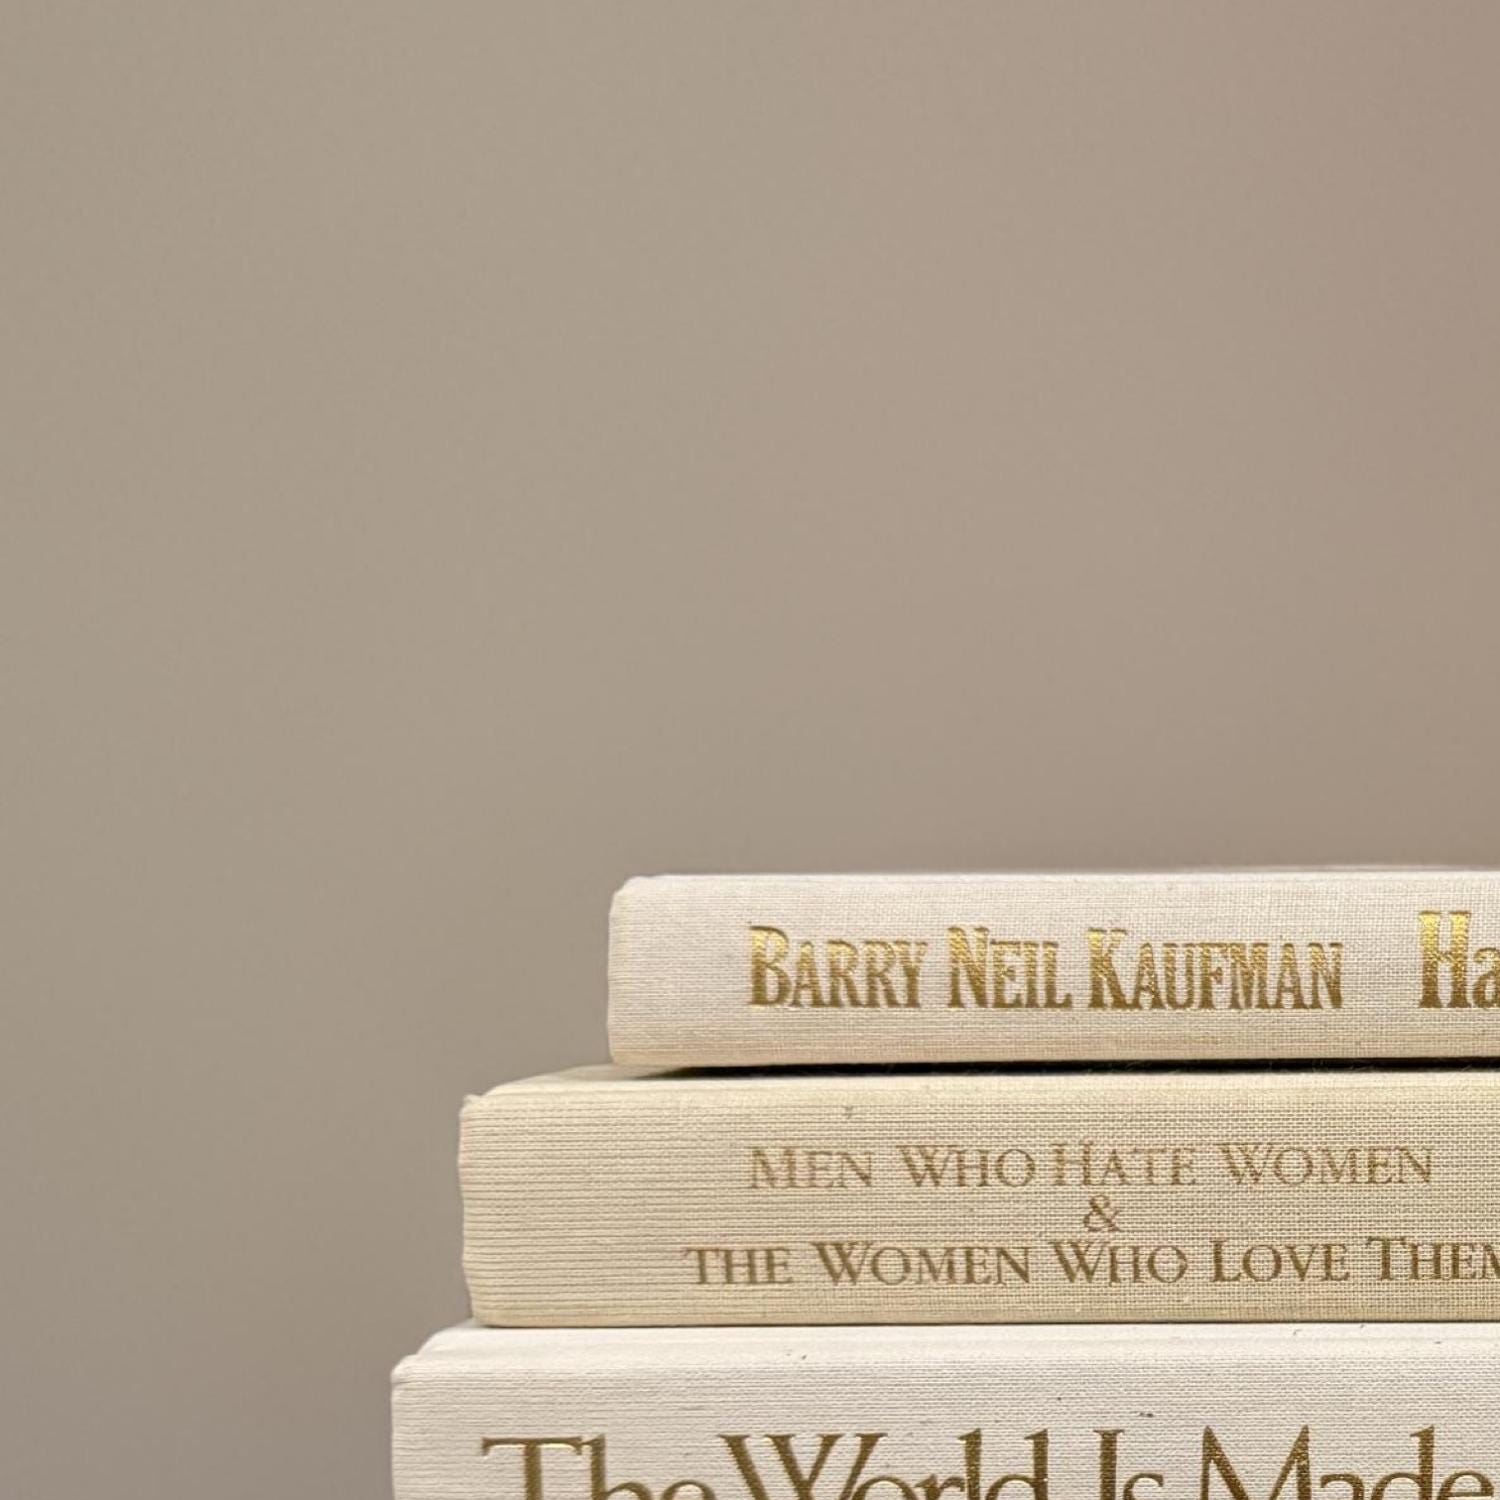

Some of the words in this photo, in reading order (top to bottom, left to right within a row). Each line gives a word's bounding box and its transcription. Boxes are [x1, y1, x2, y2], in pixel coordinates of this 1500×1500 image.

[748, 926, 928, 1010] BARRY
[947, 926, 1074, 1010] NEIL
[1087, 928, 1344, 1011] KAUFMAN
[748, 1145, 873, 1189] MEN
[900, 1143, 1036, 1188] WHO
[1051, 1140, 1197, 1187] HATE
[1217, 1142, 1435, 1186] WOMEN
[1083, 1194, 1122, 1233] &
[683, 1246, 794, 1286] THE
[811, 1240, 1032, 1287] WOMEN
[1048, 1239, 1189, 1286] WHO
[1210, 1238, 1350, 1284] LOVE
